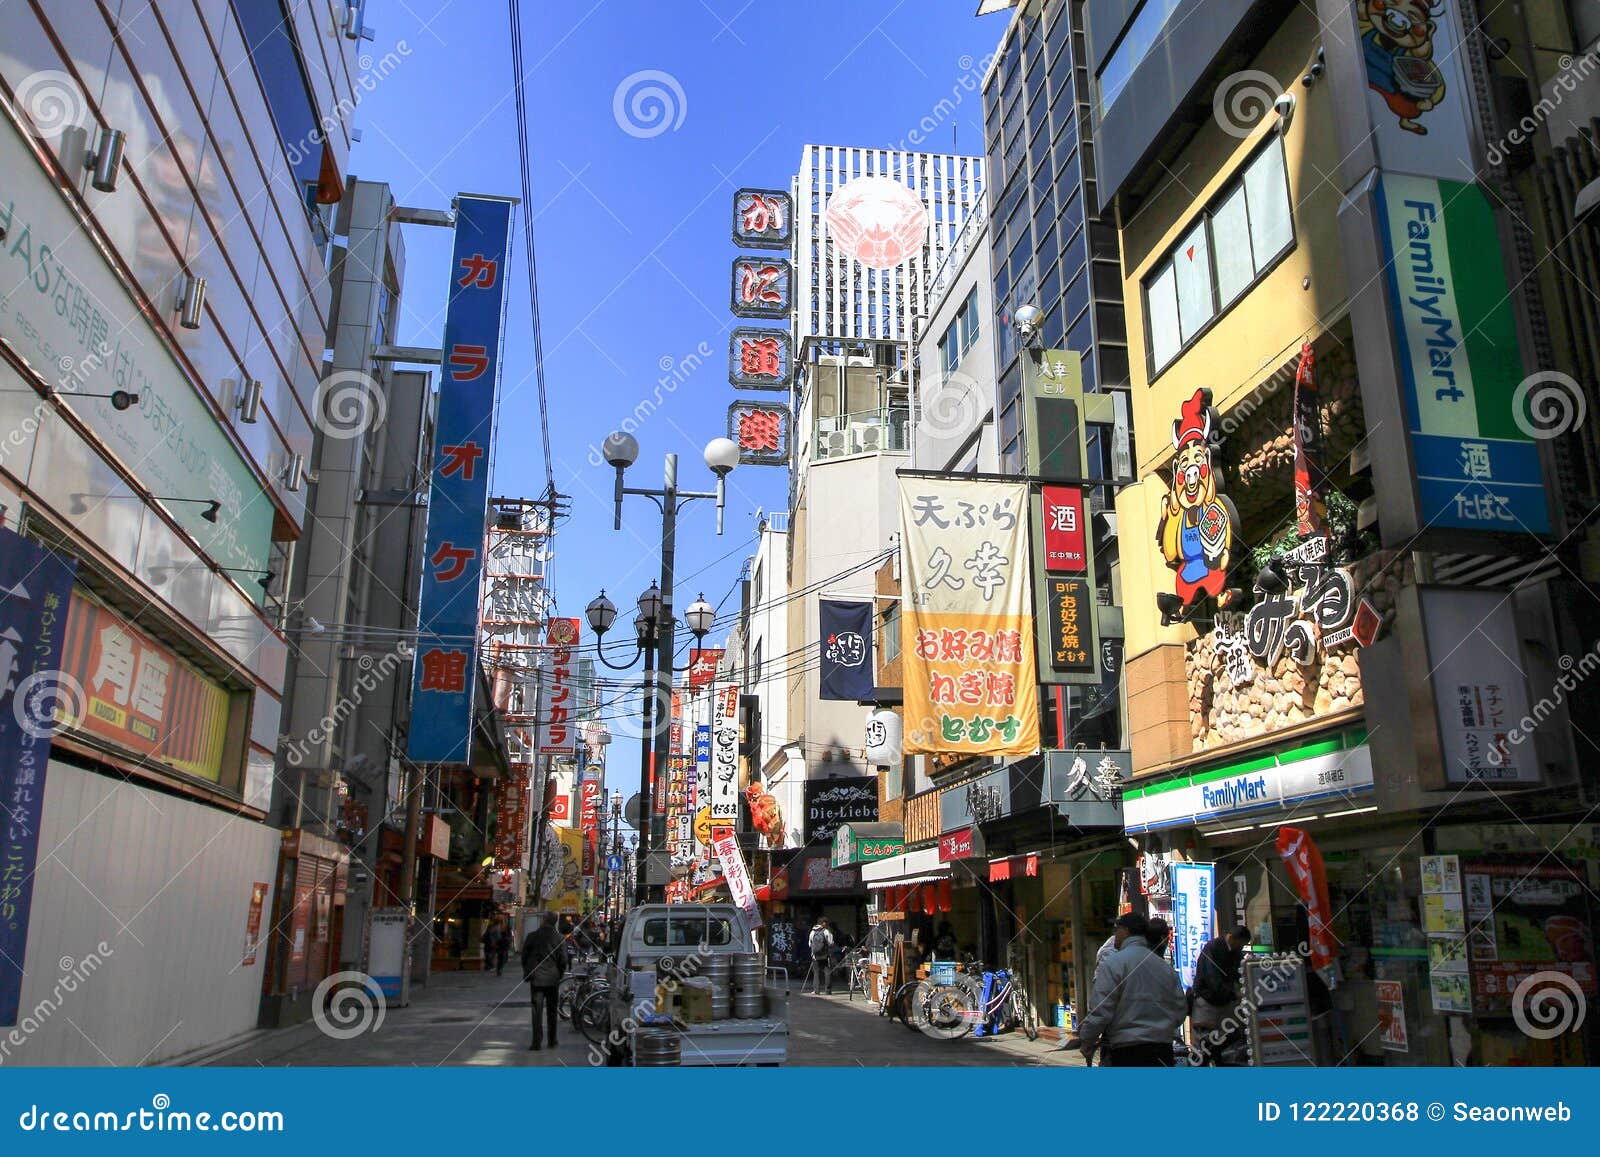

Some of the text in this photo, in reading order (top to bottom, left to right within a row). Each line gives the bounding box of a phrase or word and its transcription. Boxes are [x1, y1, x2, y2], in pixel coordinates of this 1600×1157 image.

[1404, 199, 1464, 403] FamilyMart
[739, 194, 783, 451] かに道楽
[421, 253, 497, 693] カラオケ館
[1460, 443, 1492, 479] 酒
[913, 495, 1017, 531] 天ぷら
[1050, 505, 1076, 532] 酒
[1456, 492, 1515, 522] たばこ
[926, 541, 1009, 601] 久幸
[1049, 551, 1081, 560] 年中無休
[1060, 595, 1079, 649] お好み焼
[1323, 628, 1352, 646] MITSURU
[915, 627, 1024, 664] お好み焼
[92, 623, 170, 723] 角座
[930, 670, 1017, 706] ねぎ焼
[697, 732, 708, 756] 焼肉
[712, 803, 737, 815] だるま
[1202, 774, 1267, 809] FamilyMart
[863, 843, 905, 857] とんかつ
